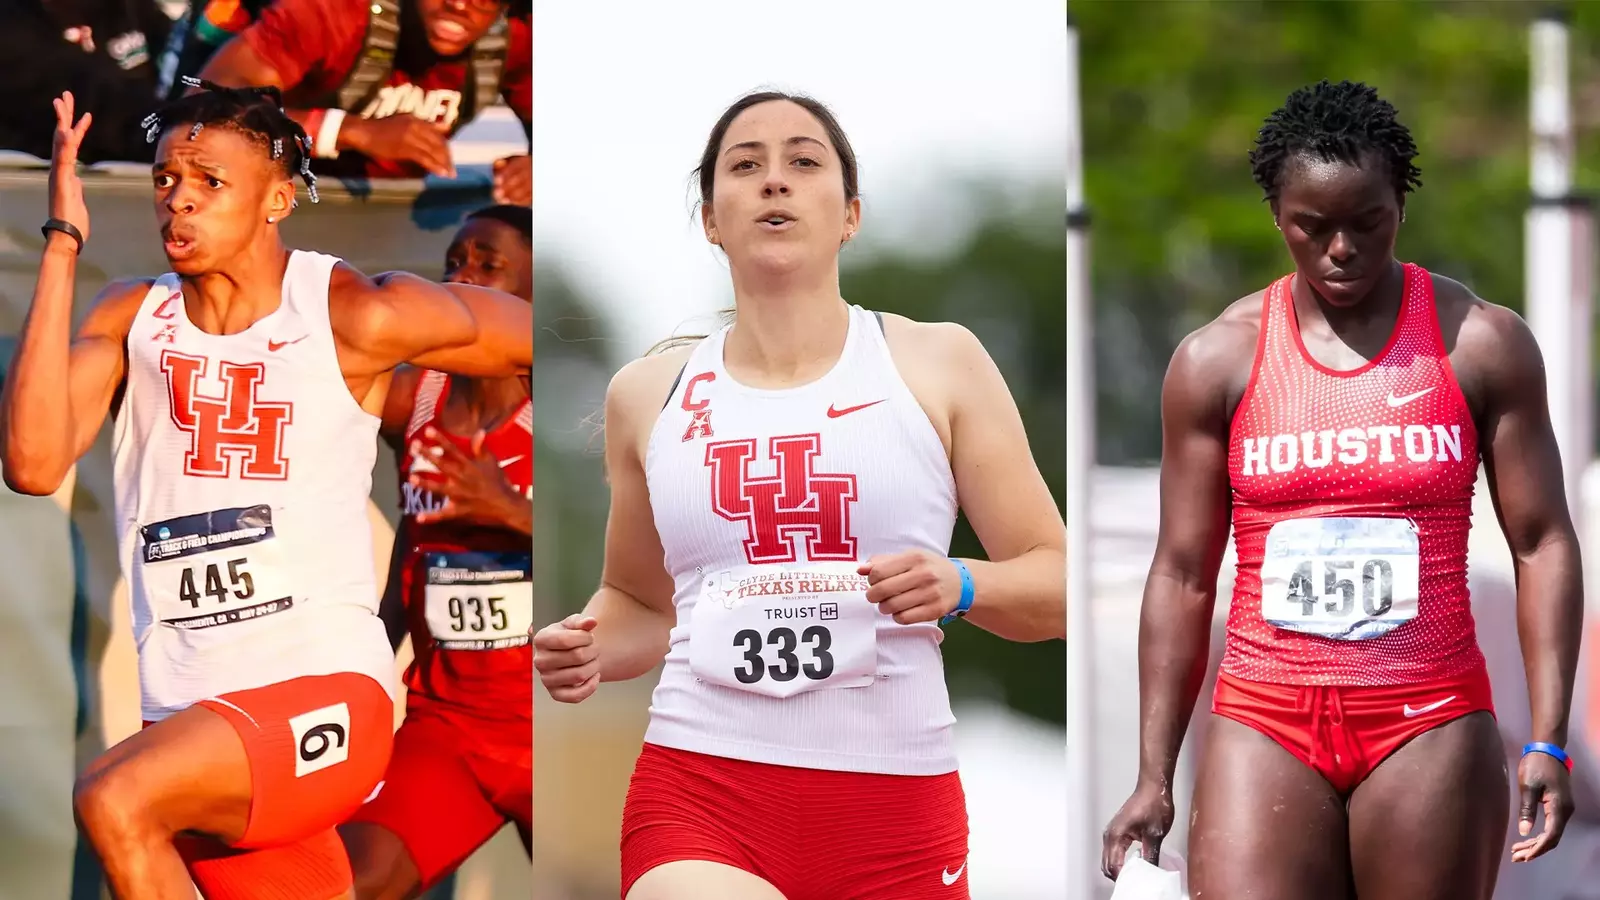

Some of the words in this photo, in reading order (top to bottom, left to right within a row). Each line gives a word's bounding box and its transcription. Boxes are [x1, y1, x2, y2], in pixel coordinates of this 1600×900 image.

[681, 371, 716, 411] C
[682, 410, 714, 442] A
[1242, 424, 1464, 476] HOUSTON
[704, 432, 858, 565] UH
[160, 541, 183, 554] TRACK
[187, 536, 207, 549] FIELD
[207, 527, 267, 545] CHAMPIONSHIPS
[179, 557, 255, 608] 445
[737, 580, 794, 599] TEXAS
[798, 580, 869, 594] RELAYS
[739, 573, 775, 588] CLYDE
[780, 572, 867, 582] LITTLEFIELD
[1286, 558, 1393, 617] 450
[448, 596, 508, 632] 935
[764, 606, 817, 620] TRUIST
[732, 625, 834, 684] 333
